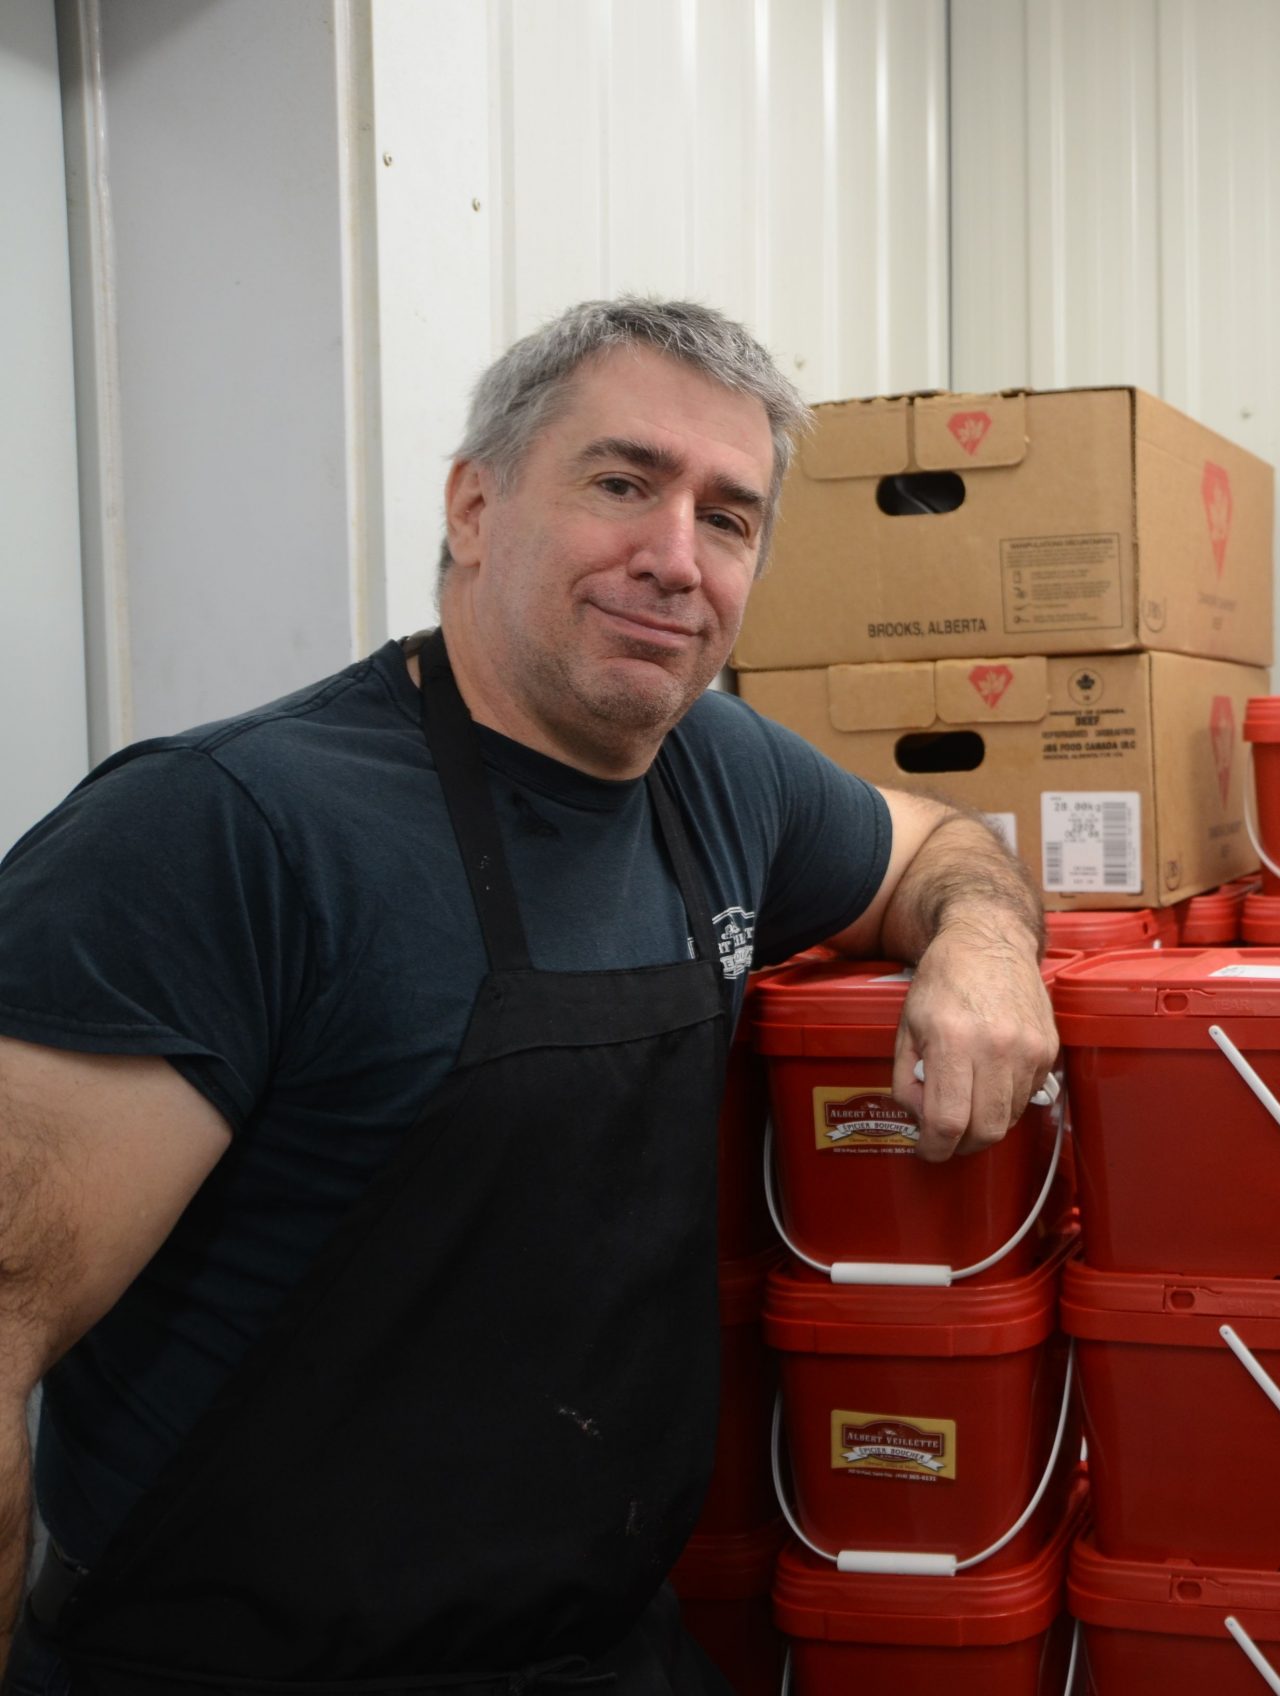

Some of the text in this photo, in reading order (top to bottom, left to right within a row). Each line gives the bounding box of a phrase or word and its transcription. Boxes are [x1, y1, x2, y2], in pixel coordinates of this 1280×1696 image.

[867, 618, 987, 638] BROOKS, ALBERTA
[1075, 715, 1100, 726] BEEF
[1060, 742, 1082, 752] FOOD
[1085, 741, 1118, 751] CANADA
[830, 1109, 866, 1119] ALBERT
[874, 1122, 909, 1133] BOUCHER
[847, 1431, 940, 1449] ALBERT VEILLETTE
[890, 1448, 925, 1461] BOUCHER
